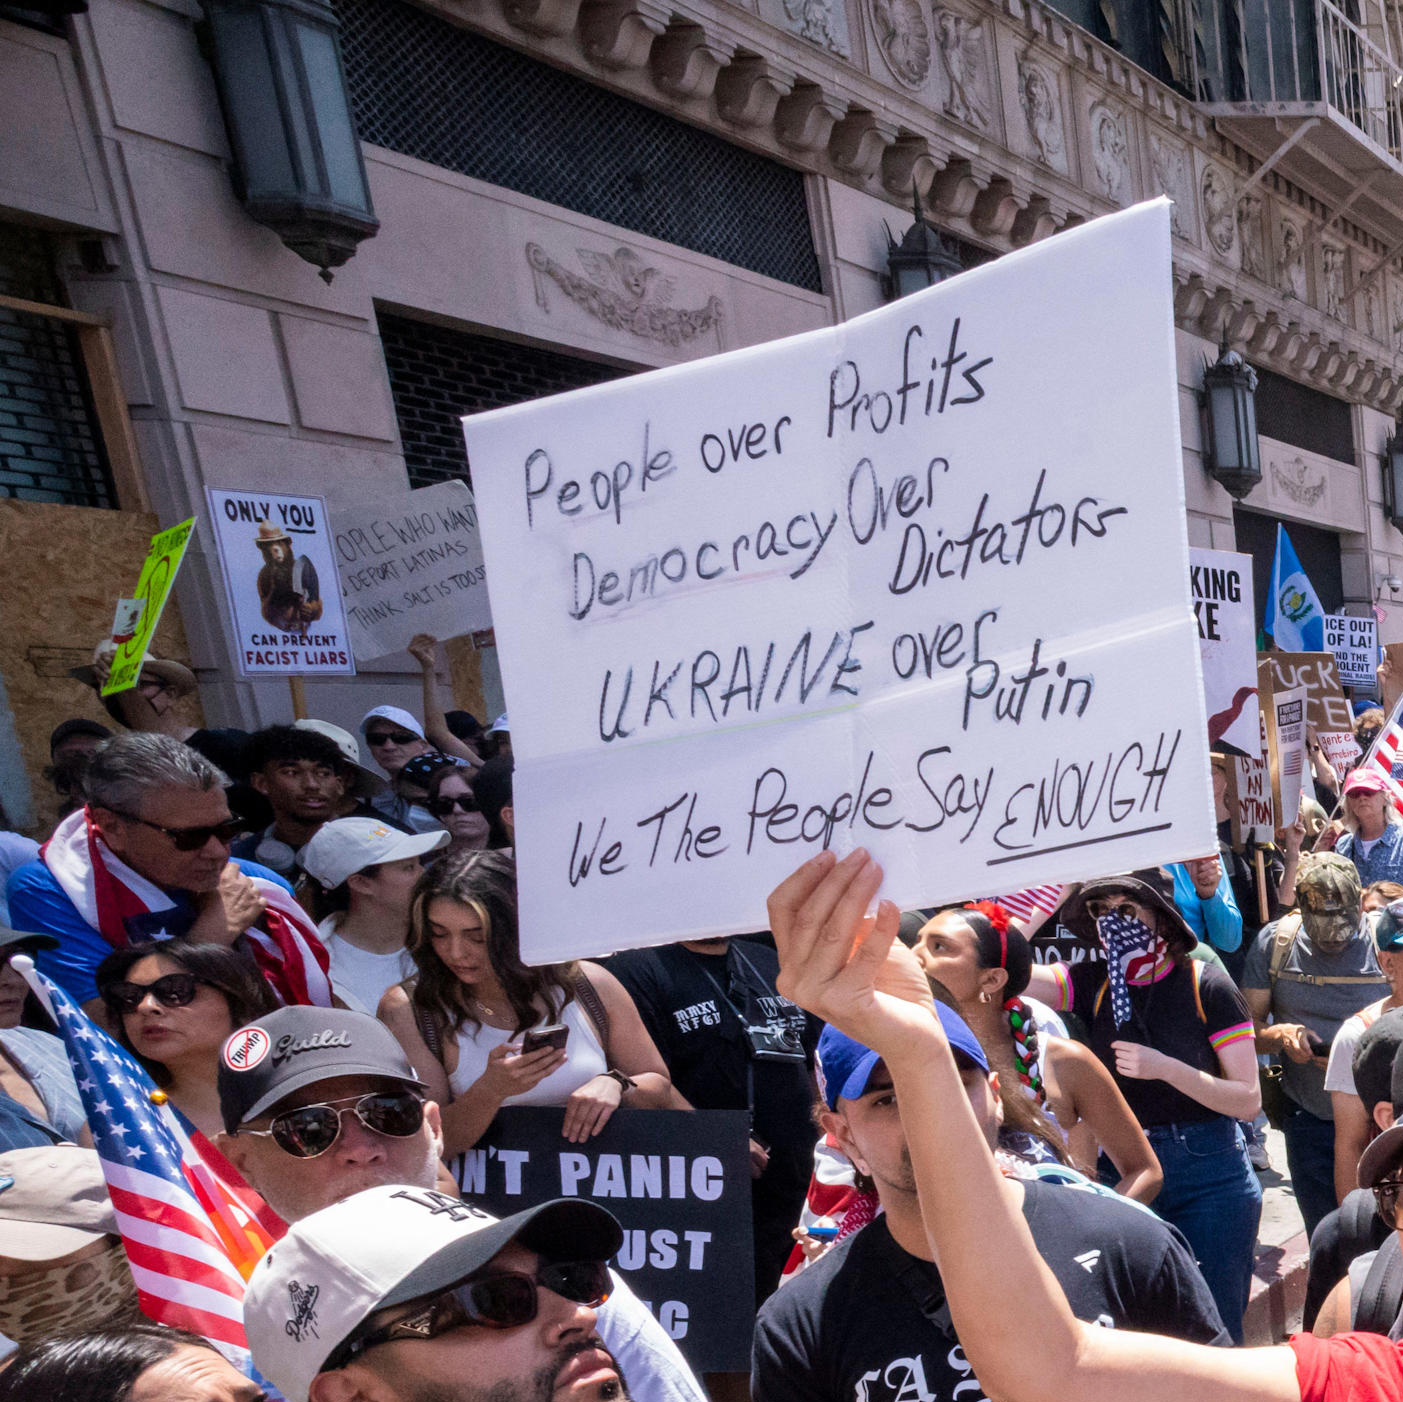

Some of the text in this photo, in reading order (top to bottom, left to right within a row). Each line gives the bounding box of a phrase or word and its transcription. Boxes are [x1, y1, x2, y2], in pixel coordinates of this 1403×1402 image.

[525, 318, 995, 531] People over Profits
[224, 498, 315, 527] ONLY YOU
[888, 469, 1129, 595] Dictators
[336, 523, 395, 568] OPLE
[388, 512, 436, 547] WHO
[568, 456, 950, 621] Democracy Over
[348, 540, 469, 593] DEPORT LATINAS
[347, 597, 404, 629] THINK
[434, 579, 452, 598] IS
[1325, 618, 1374, 633] ICE OUT
[246, 650, 348, 666] FACIST LIARS
[251, 633, 338, 648] CAN PREVENT
[1327, 633, 1373, 649] OF LA!
[1335, 651, 1369, 663] ND THE
[599, 606, 1001, 742] UKRAINE over
[962, 638, 1095, 732] Putin
[1335, 661, 1371, 673] IOLENT
[568, 820, 629, 889] We
[637, 792, 731, 865] The
[746, 749, 902, 854] People
[905, 745, 994, 844] Say
[992, 728, 1183, 850] ENOUGH
[231, 1031, 261, 1065] TRUMP
[271, 1029, 352, 1068] Guild
[451, 1147, 724, 1202] N'T PANIC
[612, 1229, 712, 1271] UST
